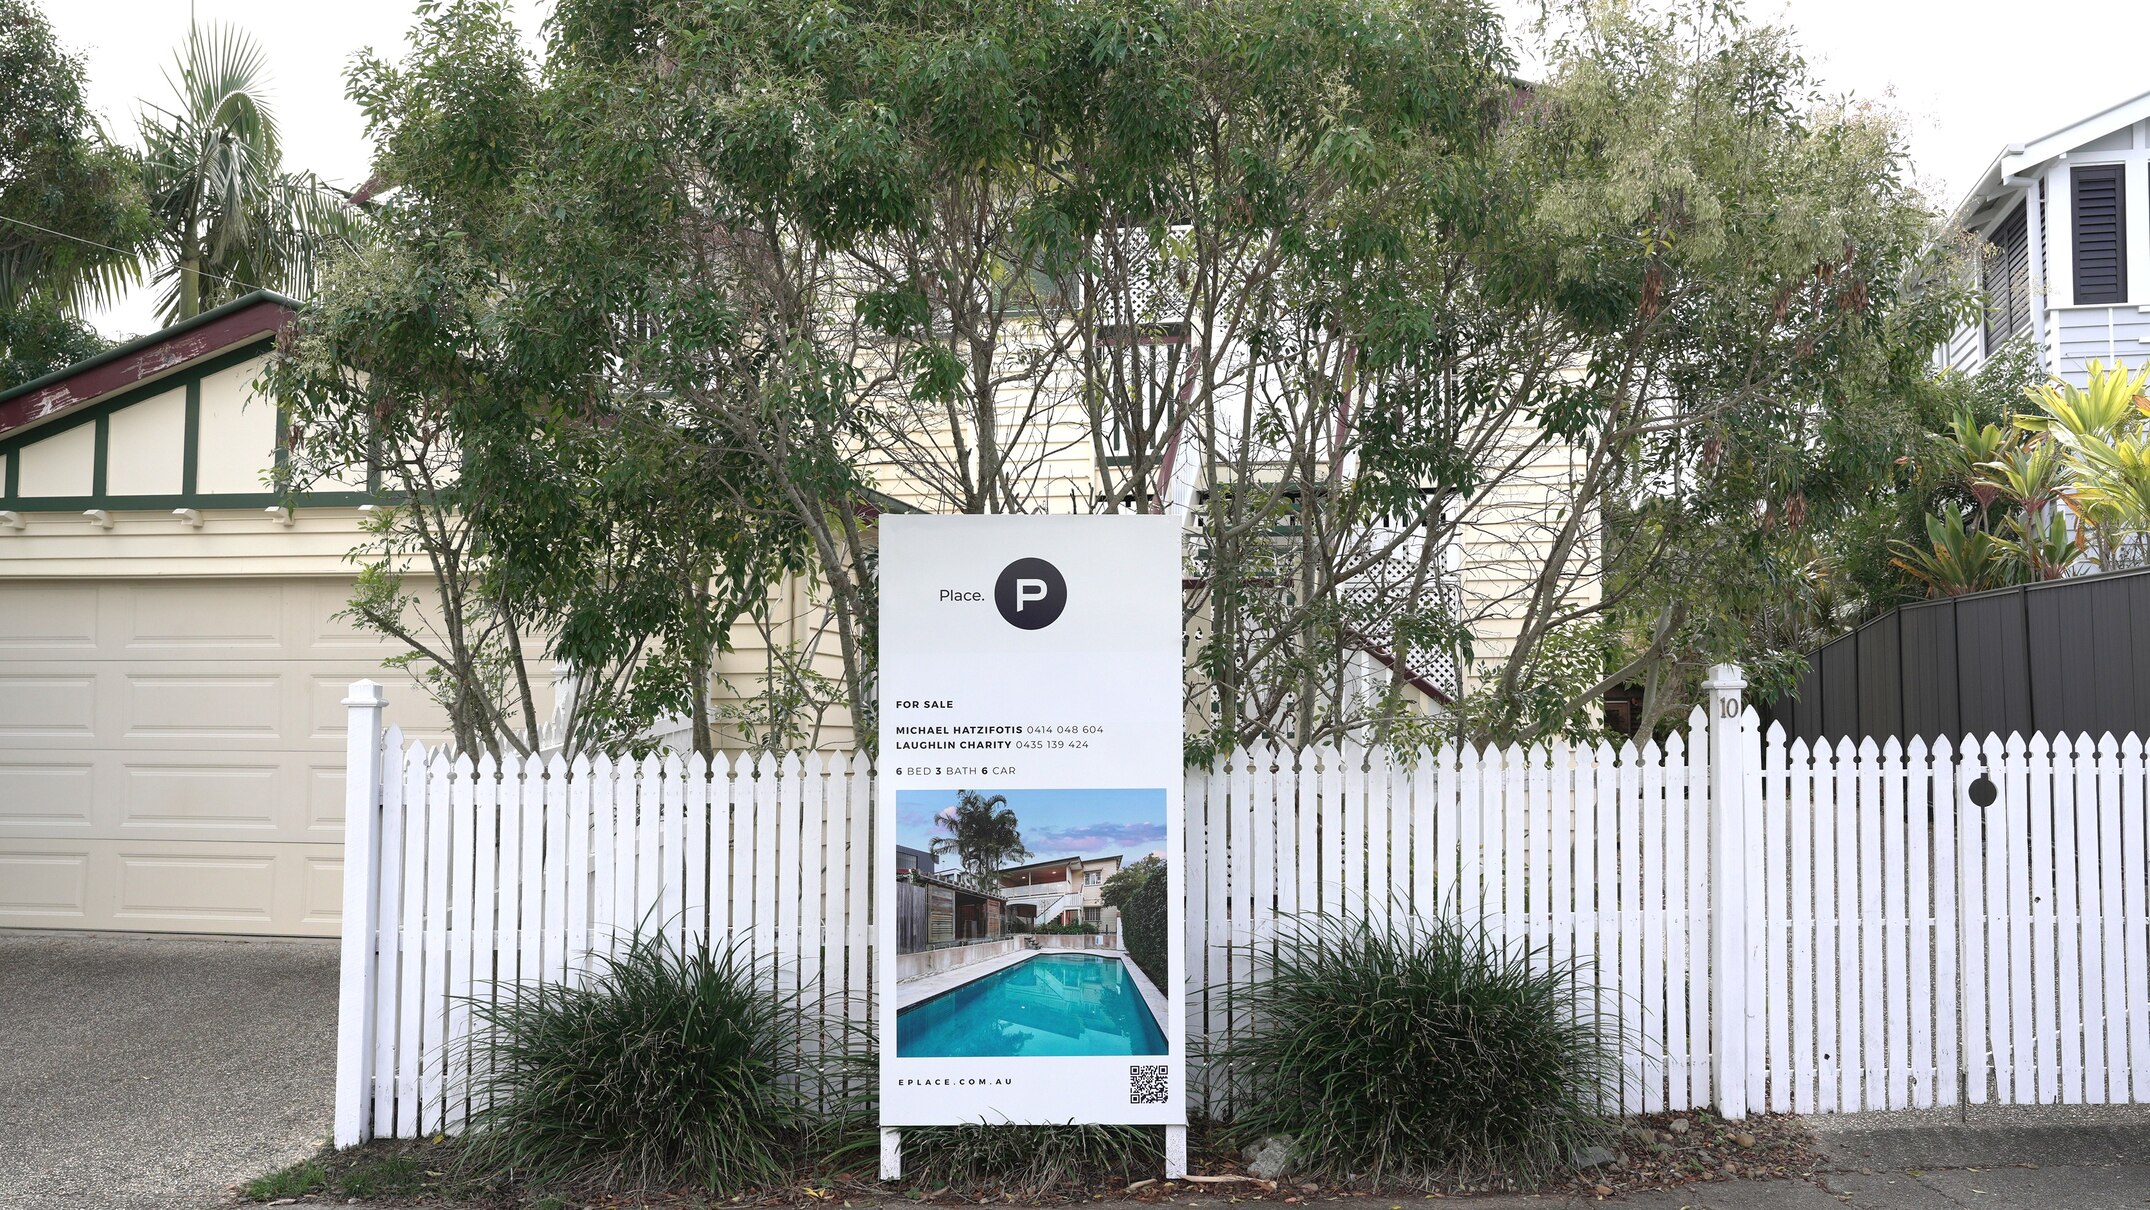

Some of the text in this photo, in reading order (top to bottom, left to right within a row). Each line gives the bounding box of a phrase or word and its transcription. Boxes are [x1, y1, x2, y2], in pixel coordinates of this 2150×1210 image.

[939, 578, 1048, 612] Place. P
[895, 700, 954, 709] FOR SALE
[1719, 696, 1739, 719] 10
[895, 725, 1104, 735] MICHAEL HATZIFOTIS 0414 048 604
[895, 740, 1089, 750] LAUGHLIN CHARITY 0435 139 424
[895, 766, 1016, 776] 6 BED 3 BATH 6 CAR
[898, 1078, 1012, 1086] EPLACE.COM.AU
